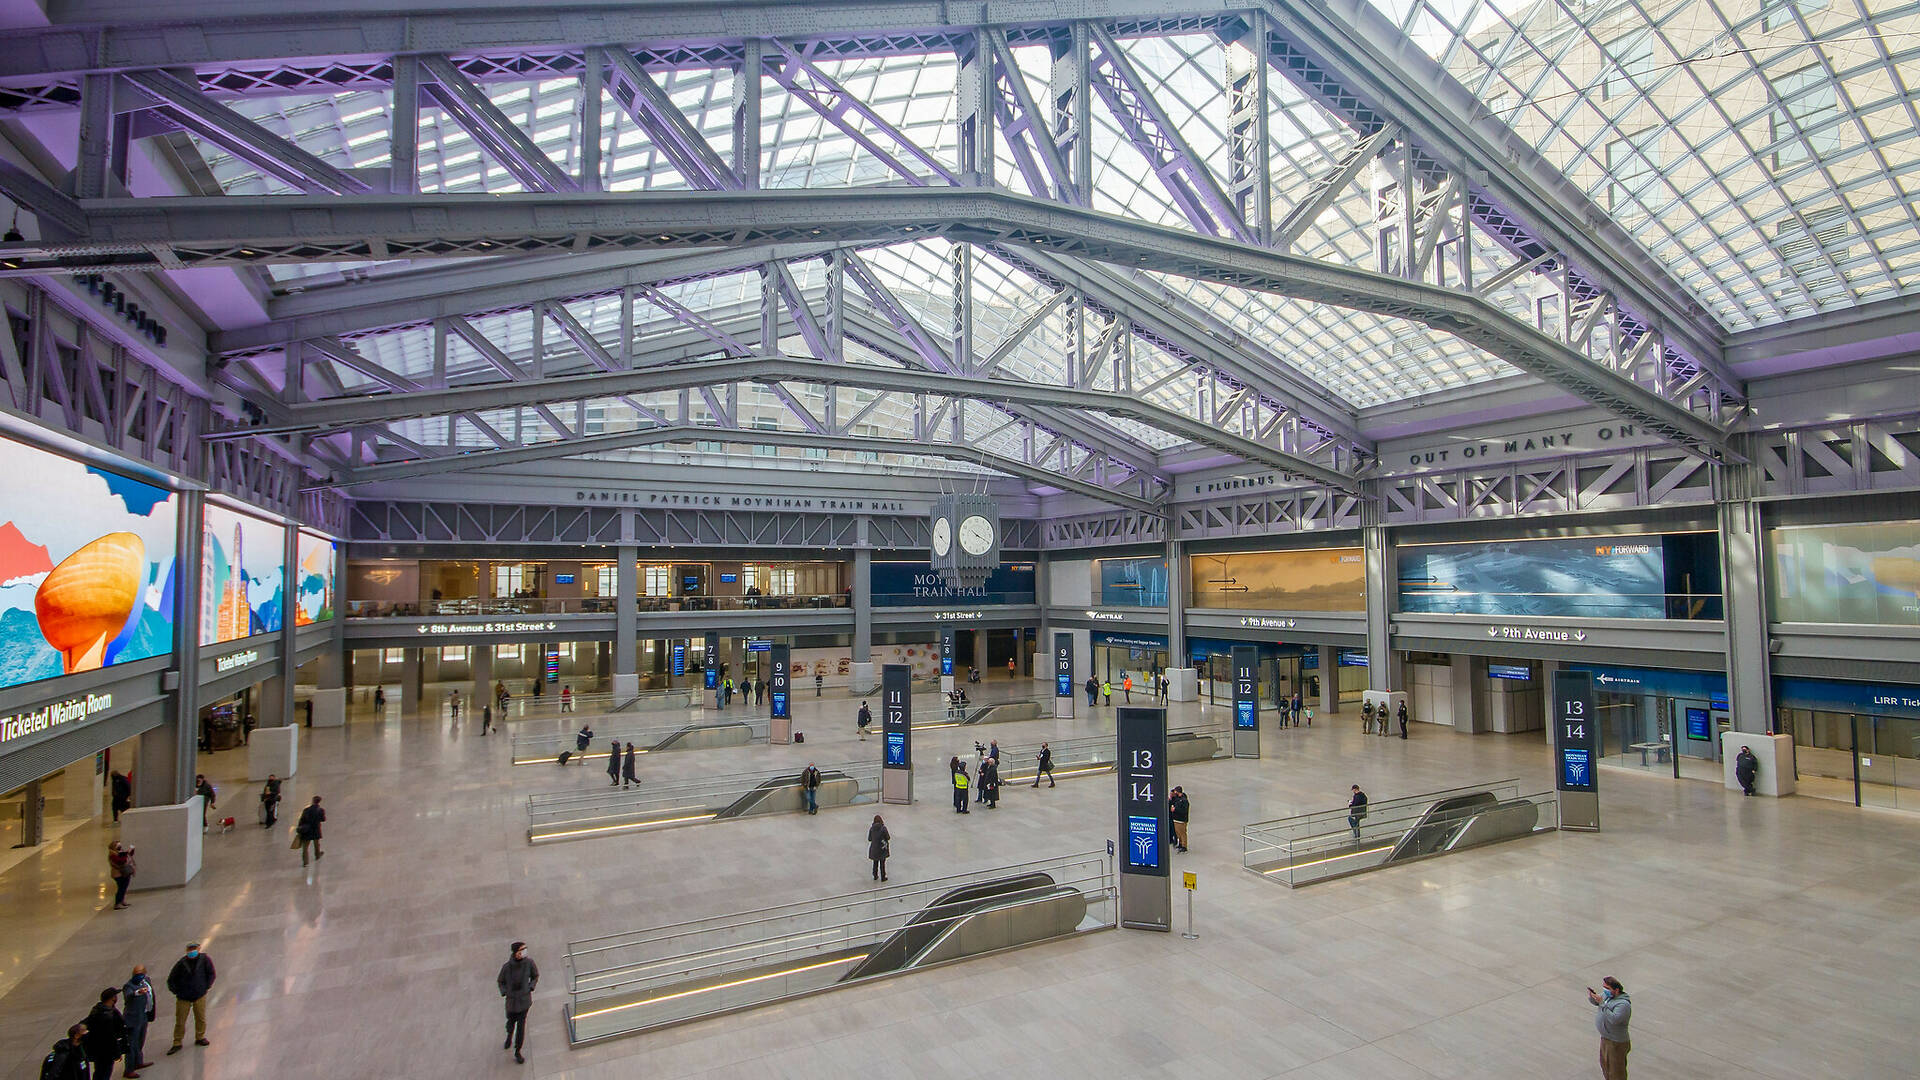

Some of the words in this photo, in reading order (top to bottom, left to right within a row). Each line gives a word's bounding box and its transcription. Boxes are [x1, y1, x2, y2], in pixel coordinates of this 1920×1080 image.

[1410, 450, 1449, 466] OUT
[1463, 444, 1488, 458] OF
[1504, 433, 1573, 453] MANY
[1598, 424, 1650, 440] ON
[1196, 485, 1200, 494] E
[1208, 475, 1274, 492] PLURIBUS
[577, 491, 639, 503] DANIEL
[650, 494, 721, 505] PATRICK
[731, 497, 811, 508] MOYNIHAN
[821, 500, 863, 510] TRAIN
[872, 502, 904, 511] HALL
[913, 586, 953, 597] TRAIN
[957, 586, 987, 597] HALL
[942, 611, 956, 619] 31st
[956, 611, 975, 620] Street
[430, 624, 447, 633] 8th
[449, 623, 484, 633] Avenue
[485, 623, 494, 632] &
[495, 622, 515, 631] 31st
[516, 622, 545, 631] Street
[1249, 617, 1259, 626] 9th
[1261, 618, 1286, 628] Avenue
[1503, 626, 1522, 638] 9th
[1524, 628, 1569, 641] Avenue
[708, 645, 714, 653] 7
[944, 646, 950, 654] 8
[1060, 648, 1067, 657] 9
[708, 656, 714, 665] 8
[1059, 661, 1069, 670] 10
[776, 662, 783, 672] 9
[1240, 667, 1250, 678] 11
[774, 677, 785, 687] 10
[1240, 683, 1252, 694] 12
[890, 691, 901, 703] 11
[1874, 696, 1898, 706] LIRR
[1566, 700, 1584, 715] 13
[0, 706, 49, 743] Ticketed
[50, 699, 87, 727] Waiting
[87, 693, 112, 715] Room
[889, 711, 903, 724] 12
[1566, 724, 1585, 739] 14
[1131, 749, 1153, 769] 13
[1131, 782, 1154, 802] 14
